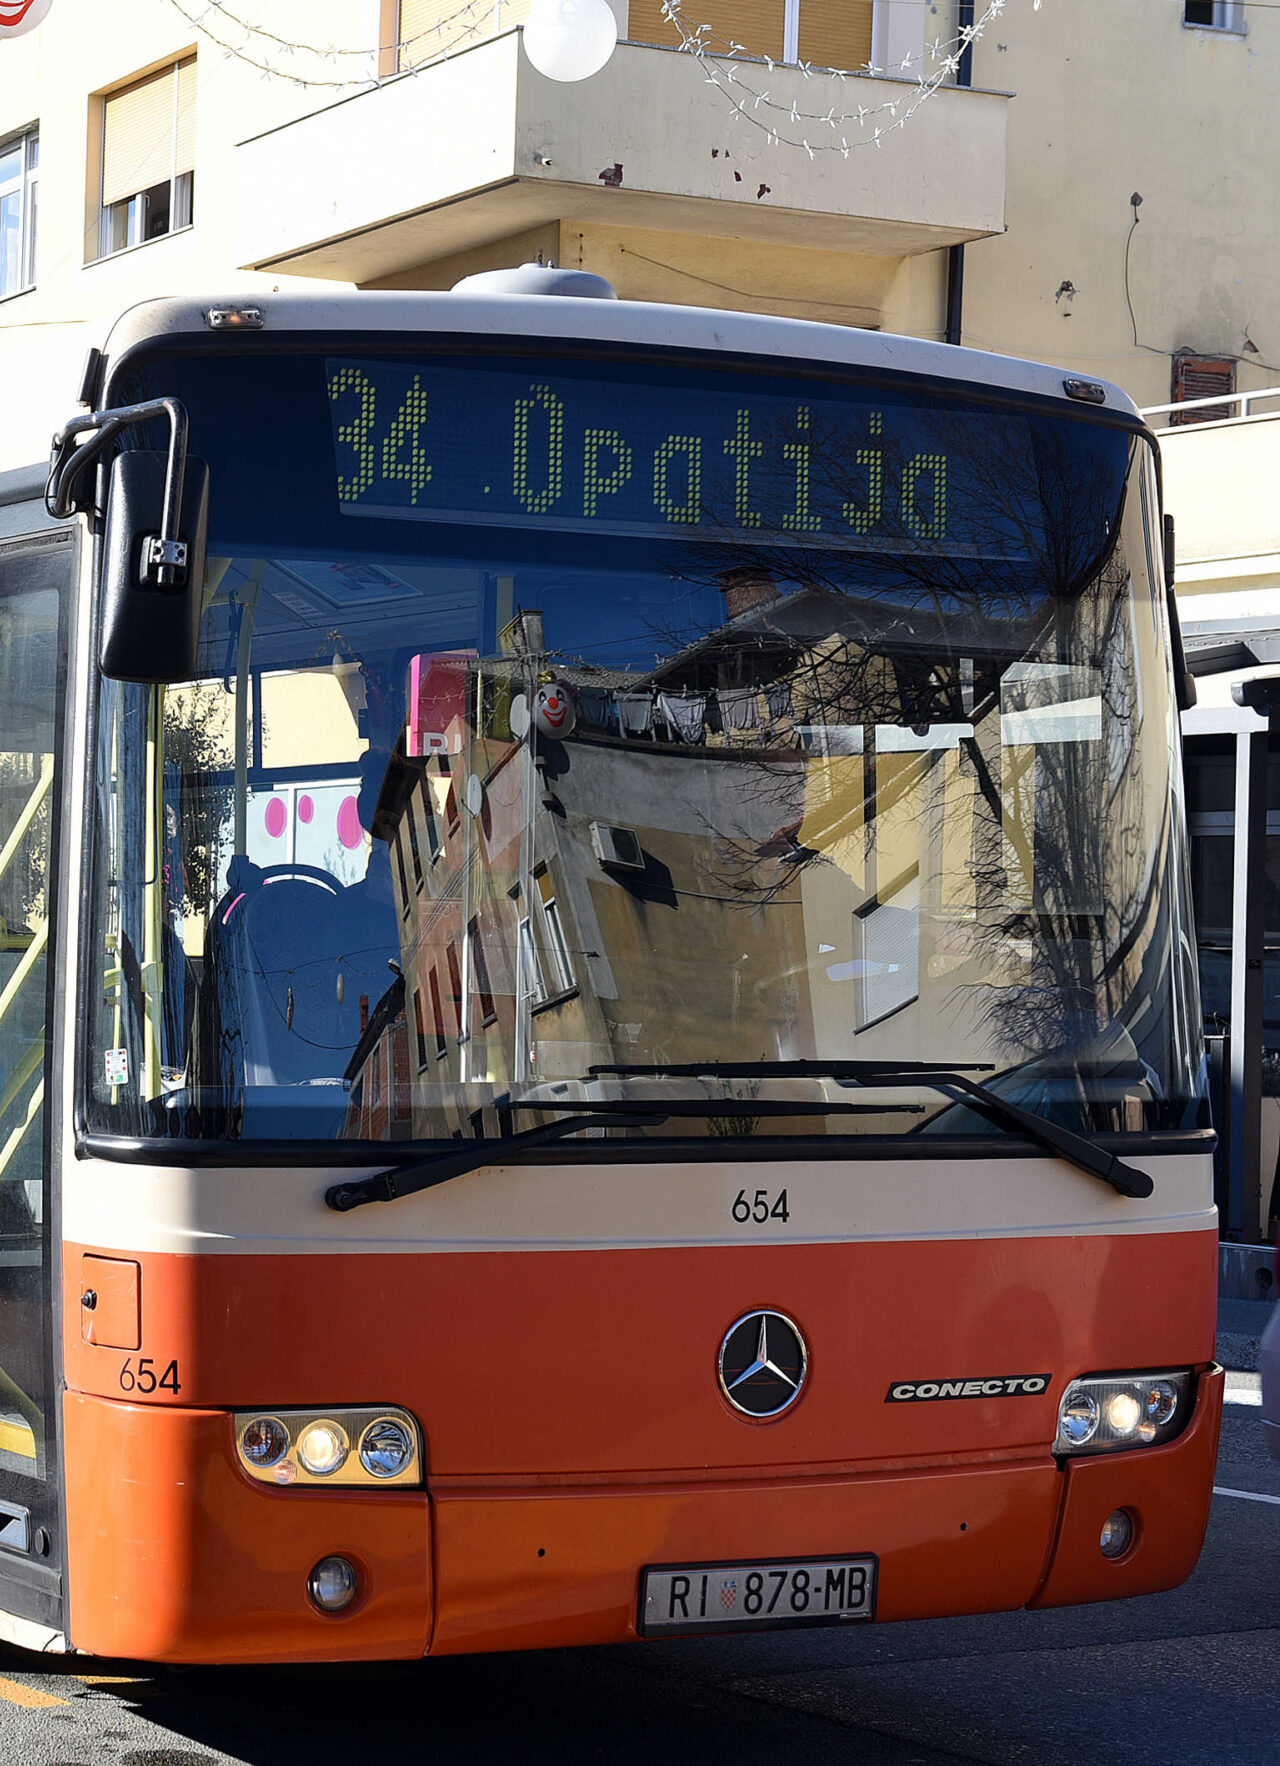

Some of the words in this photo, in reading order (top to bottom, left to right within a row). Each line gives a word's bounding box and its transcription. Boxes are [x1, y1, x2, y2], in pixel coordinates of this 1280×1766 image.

[326, 367, 433, 506] 34
[731, 1188, 790, 1224] 654
[119, 1357, 182, 1396] 654
[891, 1377, 1047, 1400] CONECTO
[668, 1575, 709, 1619] RI
[742, 1566, 869, 1615] 878-MB
